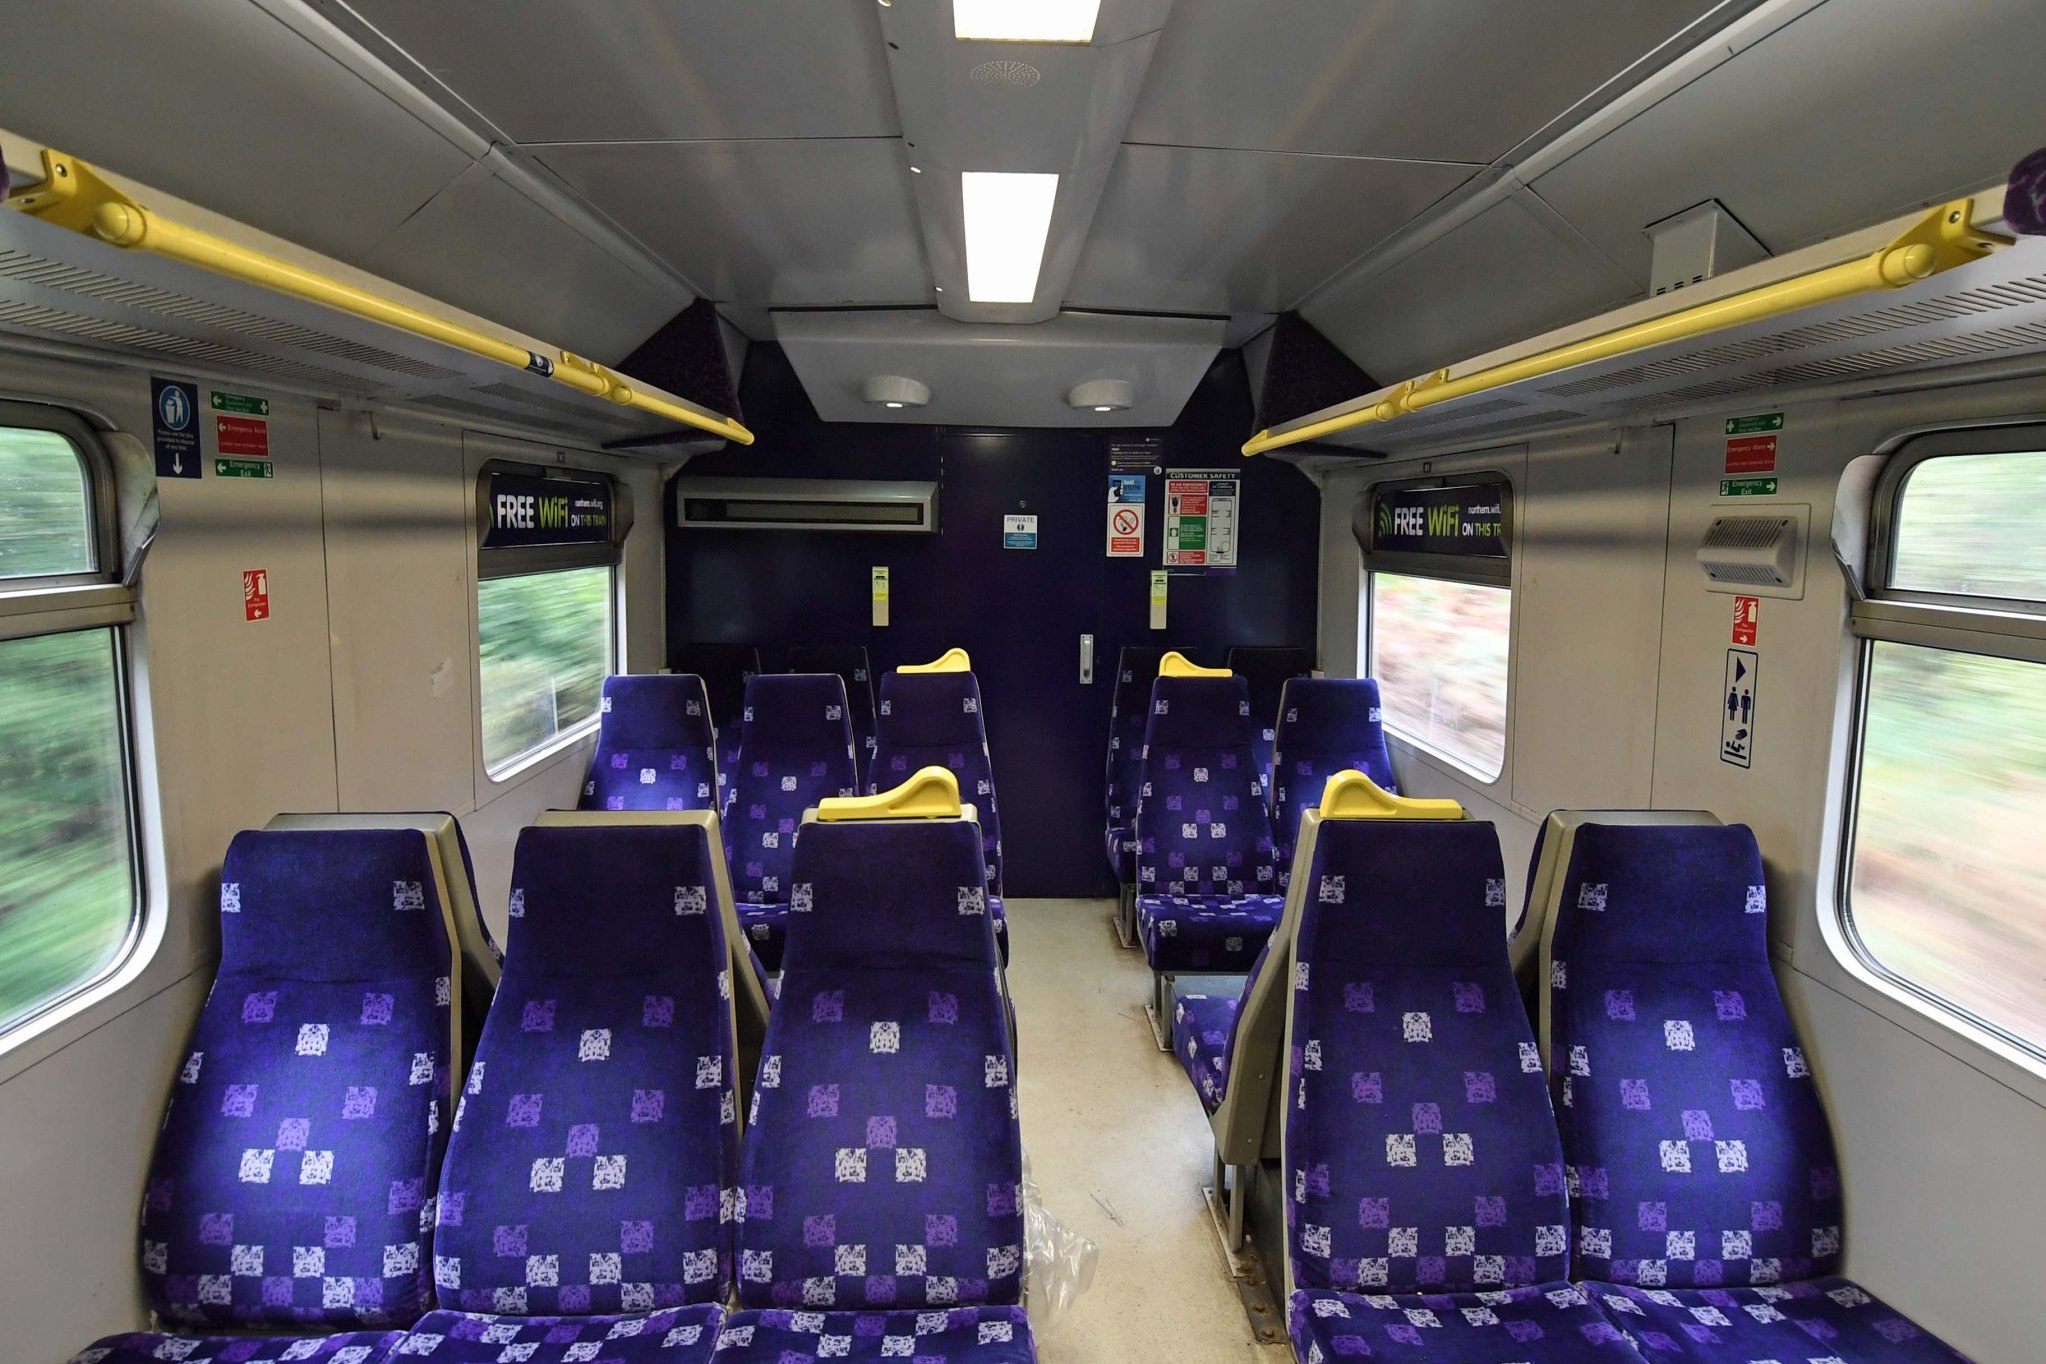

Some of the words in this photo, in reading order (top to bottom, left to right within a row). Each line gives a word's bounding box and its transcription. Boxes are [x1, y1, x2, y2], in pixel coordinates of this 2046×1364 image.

[230, 459, 261, 470] Emergency
[240, 469, 251, 477] Exit
[1732, 480, 1762, 489] Emergency
[497, 494, 534, 528] FREE
[539, 496, 568, 528] WiFi
[571, 514, 580, 527] ON
[1394, 506, 1424, 536] FREE
[1427, 504, 1459, 537] WiFi
[1462, 522, 1473, 536] ON
[1475, 522, 1490, 537] THIS
